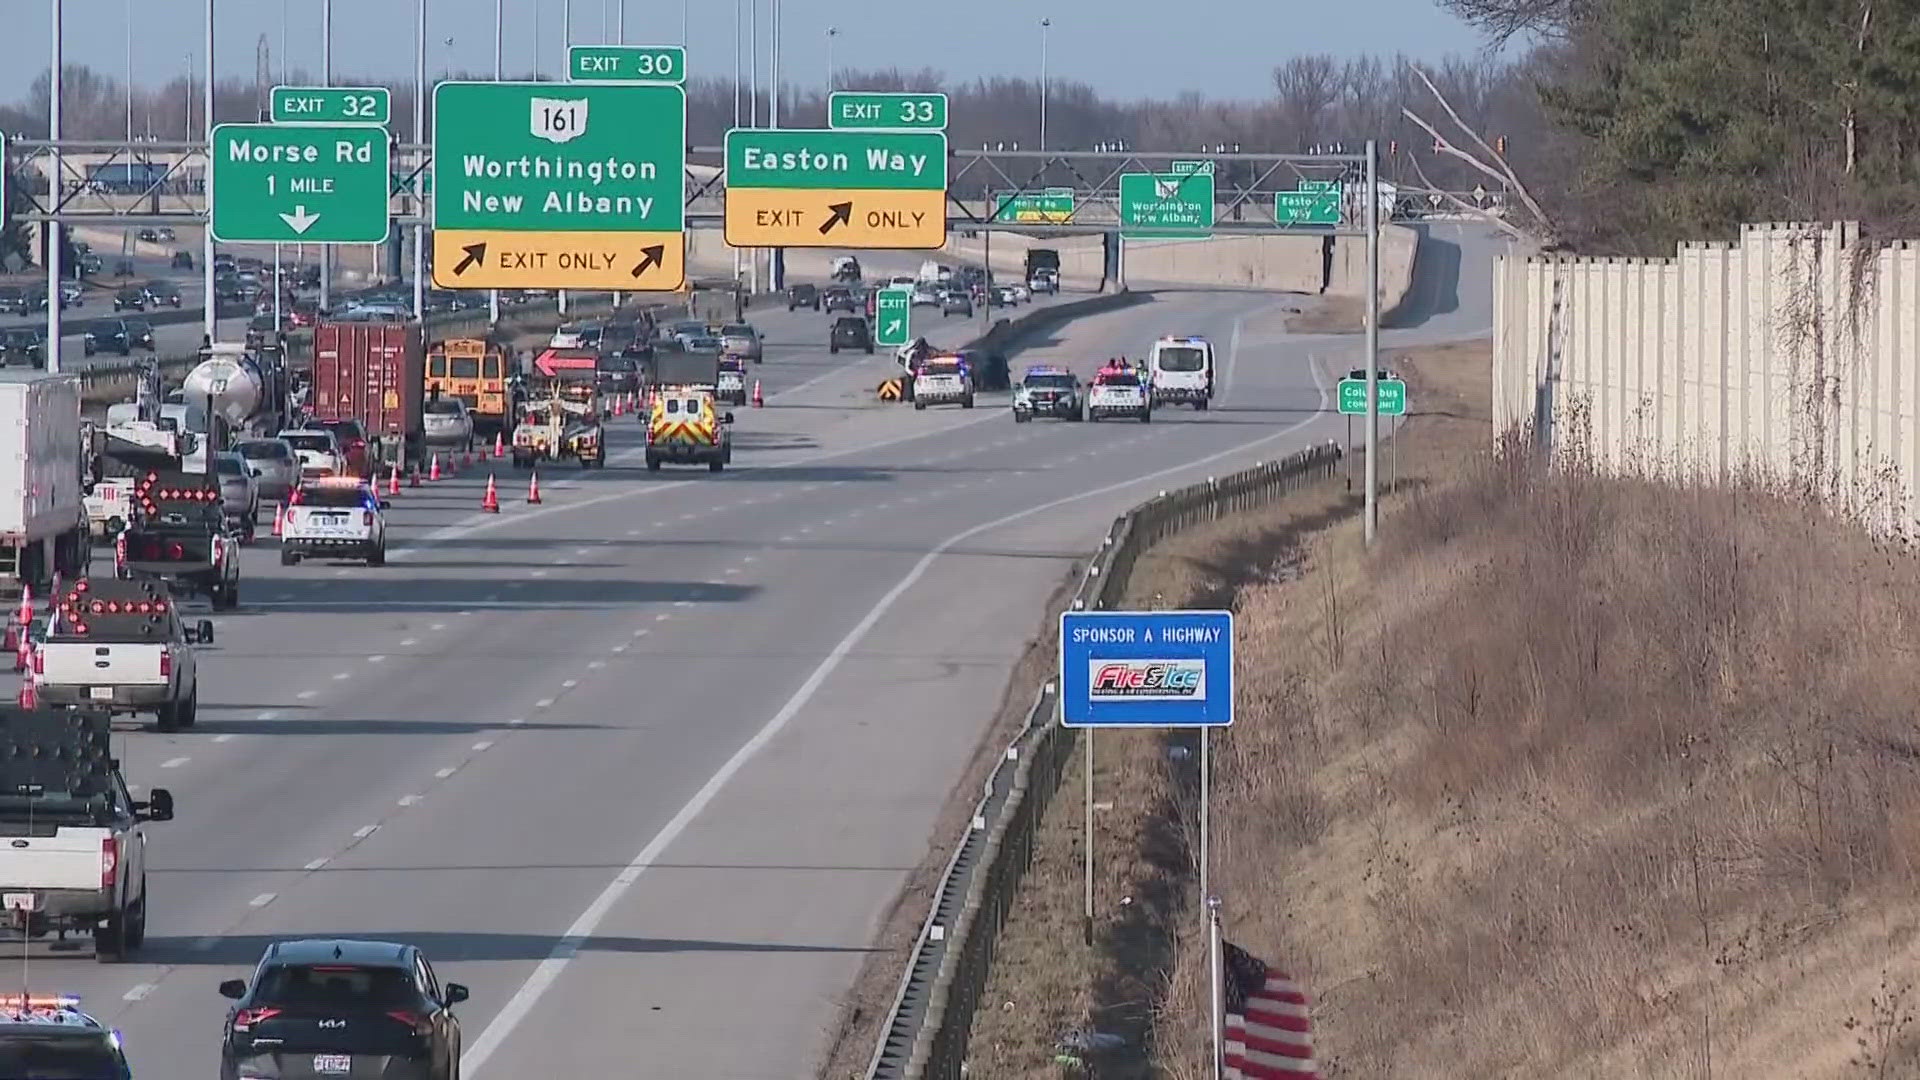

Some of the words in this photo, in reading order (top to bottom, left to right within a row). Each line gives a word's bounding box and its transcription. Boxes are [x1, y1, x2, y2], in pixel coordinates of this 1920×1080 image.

[580, 56, 619, 72] EXIT
[638, 55, 673, 74] 30
[284, 98, 324, 113] EXIT
[343, 97, 377, 116] 32
[842, 104, 882, 119] EXIT
[900, 101, 934, 122] 33
[543, 107, 576, 132] 161
[229, 141, 318, 164] Morse
[336, 141, 372, 164] Rd
[744, 148, 848, 171] Easton
[866, 149, 927, 177] Way
[463, 155, 657, 186] Worthington
[267, 175, 276, 196] 1
[290, 178, 334, 193] MILE
[463, 191, 522, 213] New
[543, 191, 654, 219] Albany
[757, 210, 804, 227] EXIT
[866, 211, 926, 228] ONLY
[500, 252, 550, 269] EXIT
[558, 252, 617, 270] ONLY
[880, 299, 906, 309] EXIT
[1072, 628, 1135, 643] SPONSOR
[1144, 628, 1153, 643] A
[1162, 628, 1222, 643] HIGHWAY
